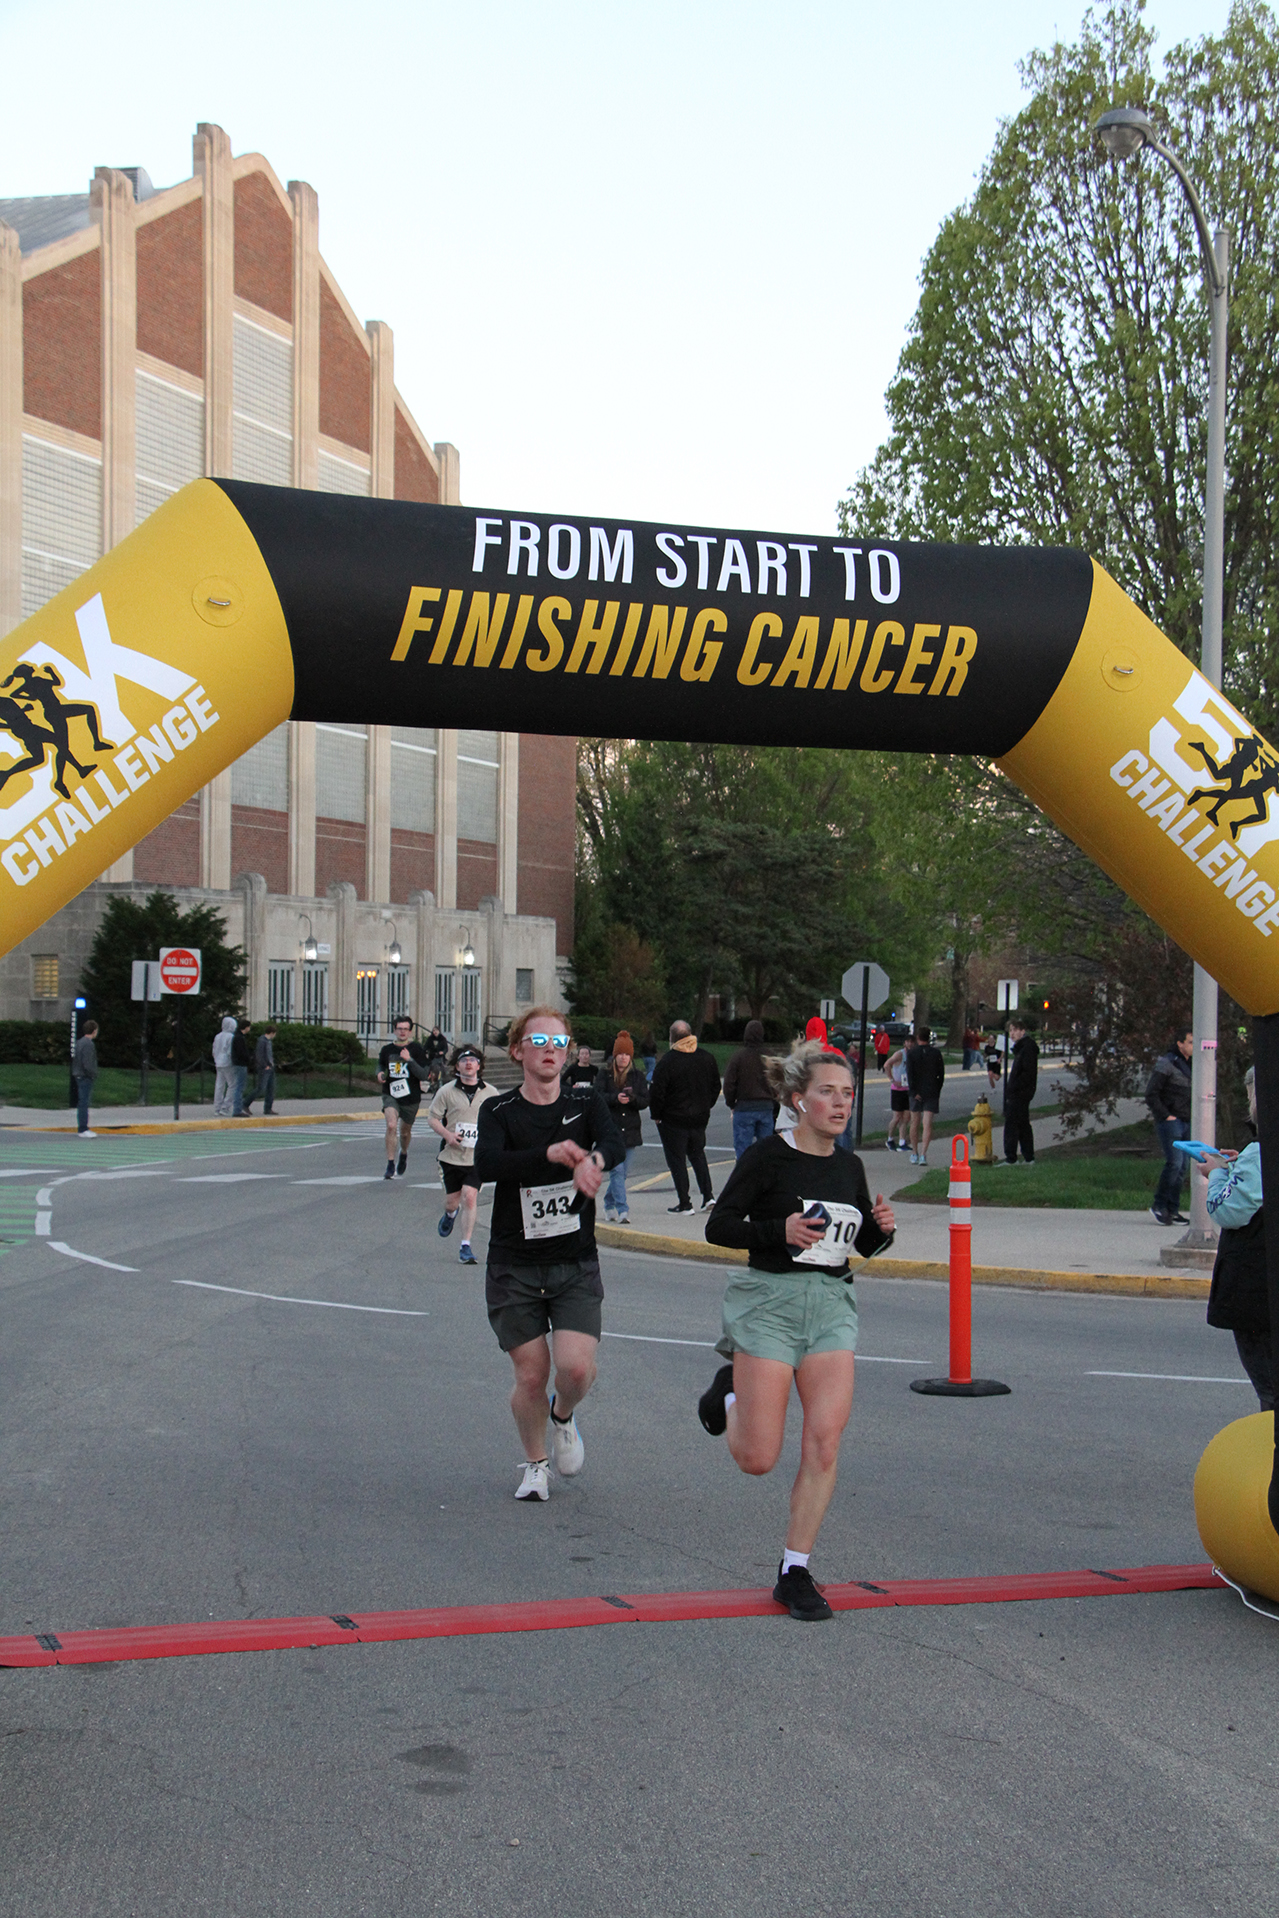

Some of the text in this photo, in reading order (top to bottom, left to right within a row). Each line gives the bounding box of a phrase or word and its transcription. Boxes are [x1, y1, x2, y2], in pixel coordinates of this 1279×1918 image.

[472, 517, 901, 605] FROM START TO
[390, 585, 979, 698] FINISHING CANCER
[1, 685, 220, 886] CHALLENGE
[166, 957, 194, 966] DO NOT
[168, 976, 191, 985] ENTER
[392, 1084, 405, 1092] 924
[532, 1196, 570, 1219] 343
